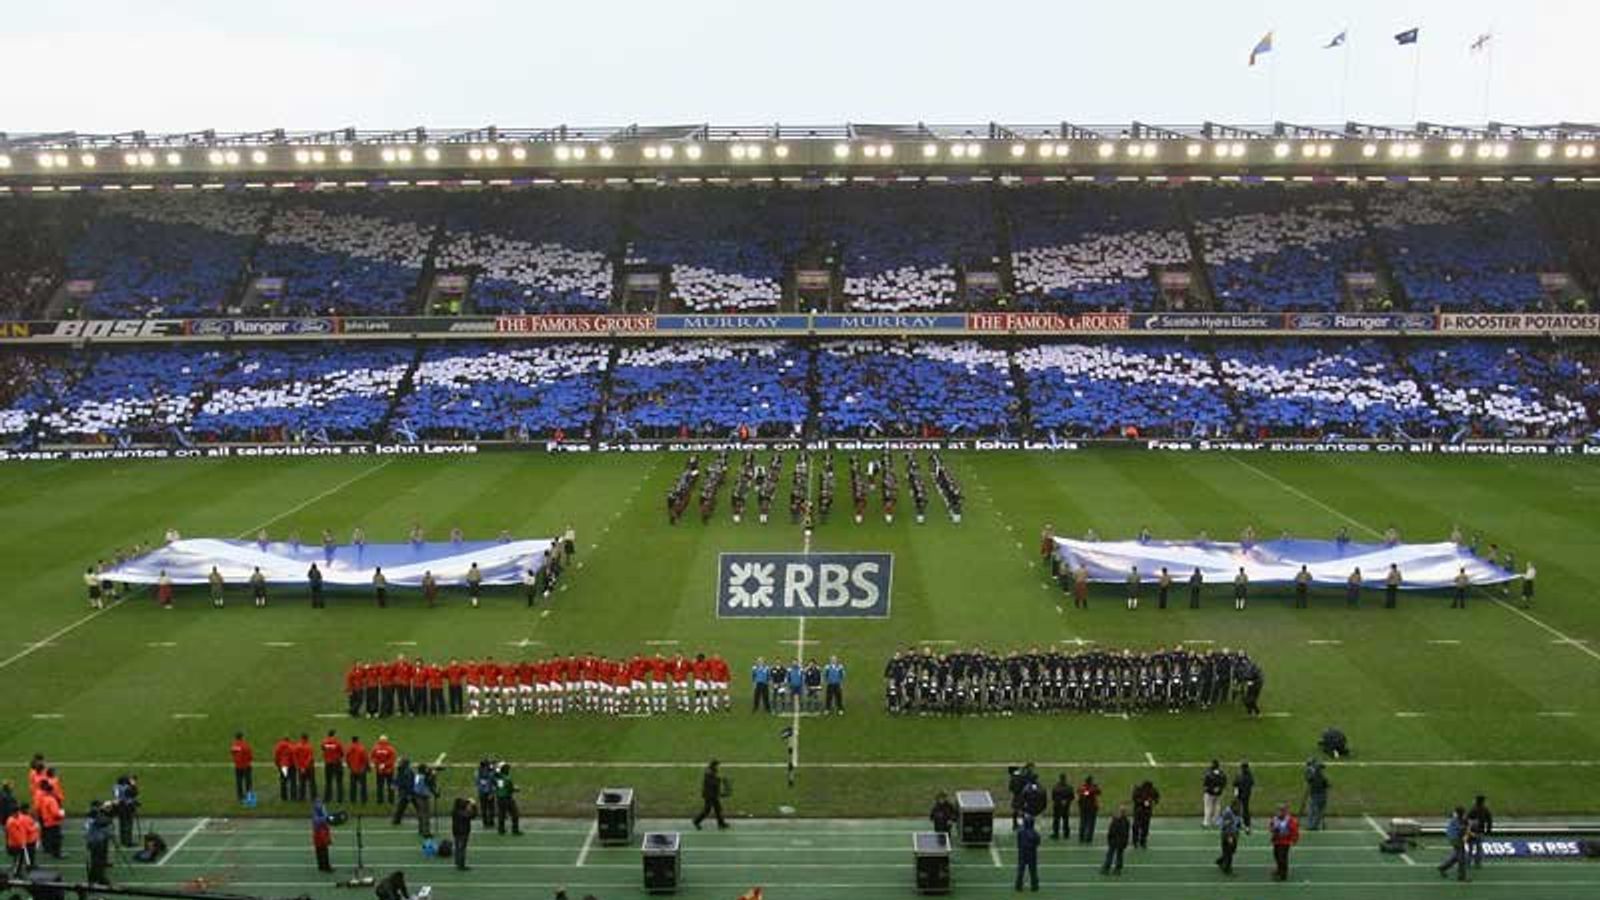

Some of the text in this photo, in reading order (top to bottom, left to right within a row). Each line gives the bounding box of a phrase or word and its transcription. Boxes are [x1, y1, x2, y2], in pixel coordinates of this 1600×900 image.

[50, 319, 182, 338] BOSE
[234, 319, 289, 335] Ranger
[498, 316, 529, 331] THE
[532, 315, 591, 331] FAMOUS
[594, 315, 655, 331] GROUSE
[683, 316, 781, 328] MURRAY
[840, 316, 938, 328] MURRAY
[972, 314, 1128, 329] THE FAMOUS GROUSE
[1334, 315, 1390, 329] Ranger
[1456, 316, 1521, 328] ROOSTER
[1525, 316, 1596, 329] POTATOES
[175, 448, 200, 458] on
[208, 447, 229, 457] all
[236, 445, 342, 456] televisions
[349, 444, 367, 454] at
[375, 443, 419, 455] John
[424, 443, 478, 454] Lewis
[547, 441, 591, 452] Free
[669, 442, 767, 452] guarantee
[773, 442, 800, 451] on
[806, 440, 828, 450] all
[835, 440, 941, 450] televisions
[948, 440, 968, 450] at
[976, 440, 1019, 451] John
[1024, 440, 1078, 450] Lewis
[1147, 440, 1192, 451] Free
[1376, 443, 1404, 452] on
[1410, 442, 1433, 453] all
[1440, 442, 1548, 454] televisions
[1554, 444, 1573, 454] at
[783, 562, 880, 609] RBS
